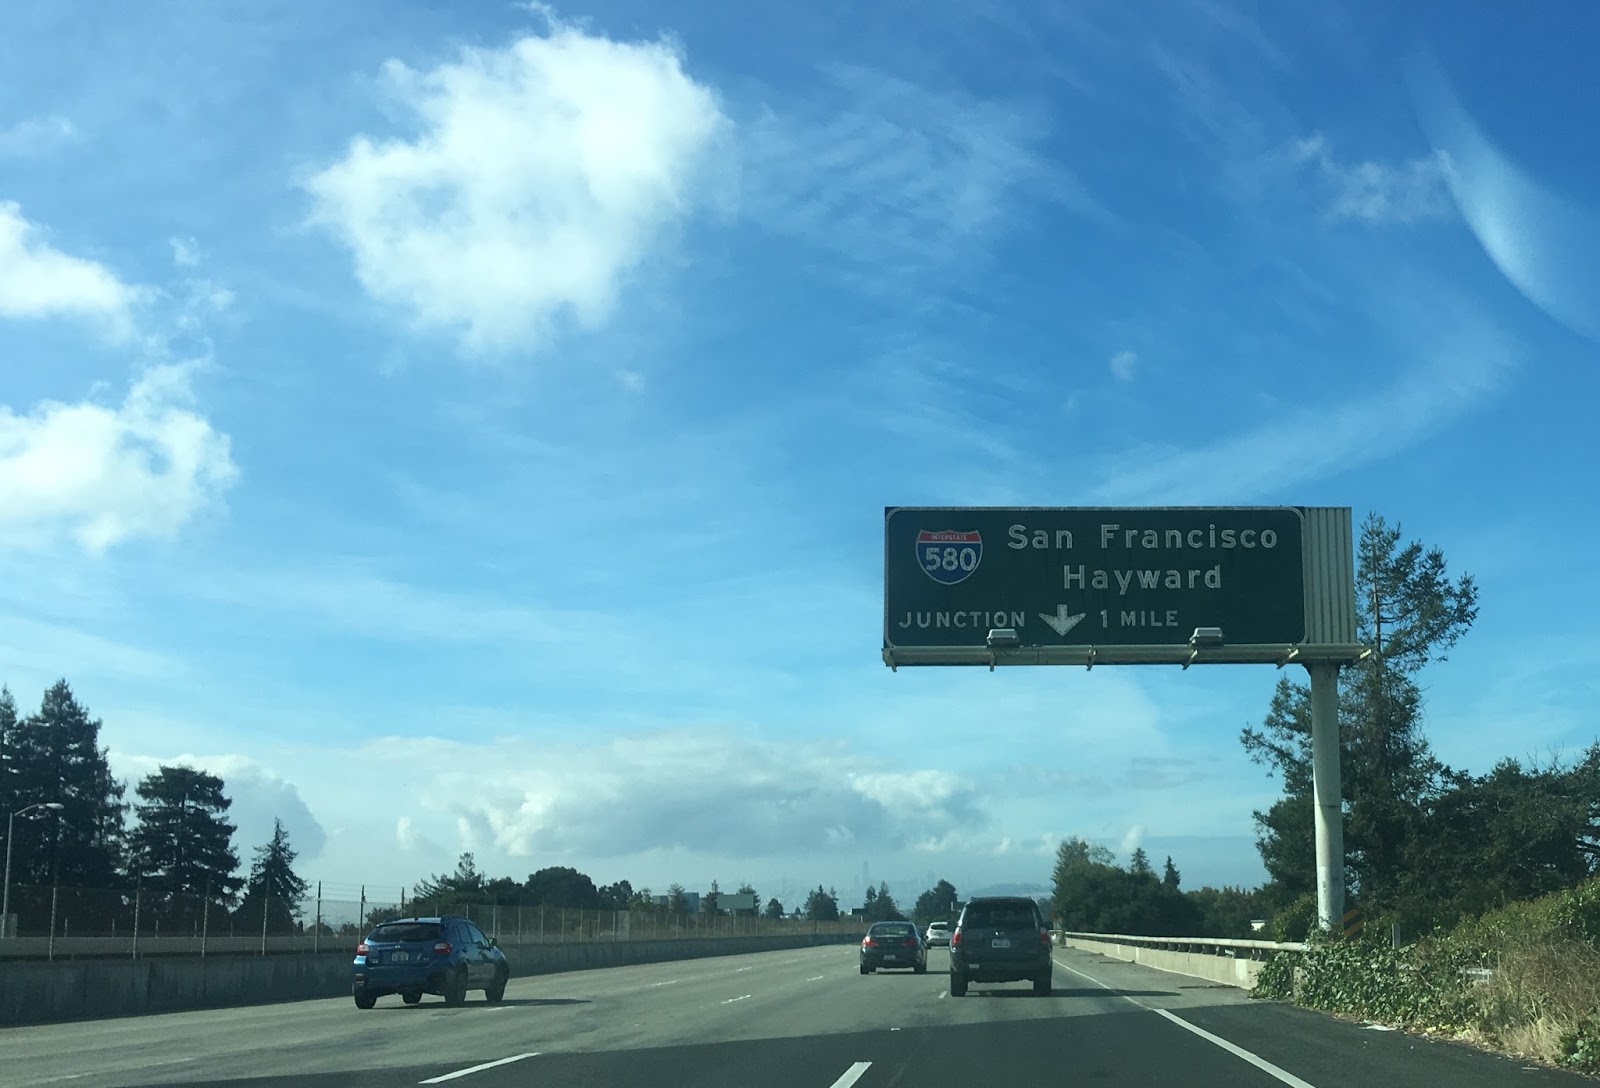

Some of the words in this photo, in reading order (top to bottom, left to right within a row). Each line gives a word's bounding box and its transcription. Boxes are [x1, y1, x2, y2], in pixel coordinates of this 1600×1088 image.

[1007, 524, 1074, 549] San
[1100, 523, 1279, 549] Francisco
[925, 547, 977, 571] 580
[1063, 564, 1222, 596] Hayward
[898, 611, 1026, 629] JUNCTION
[1100, 609, 1108, 628] 1
[1120, 610, 1179, 627] MILE
